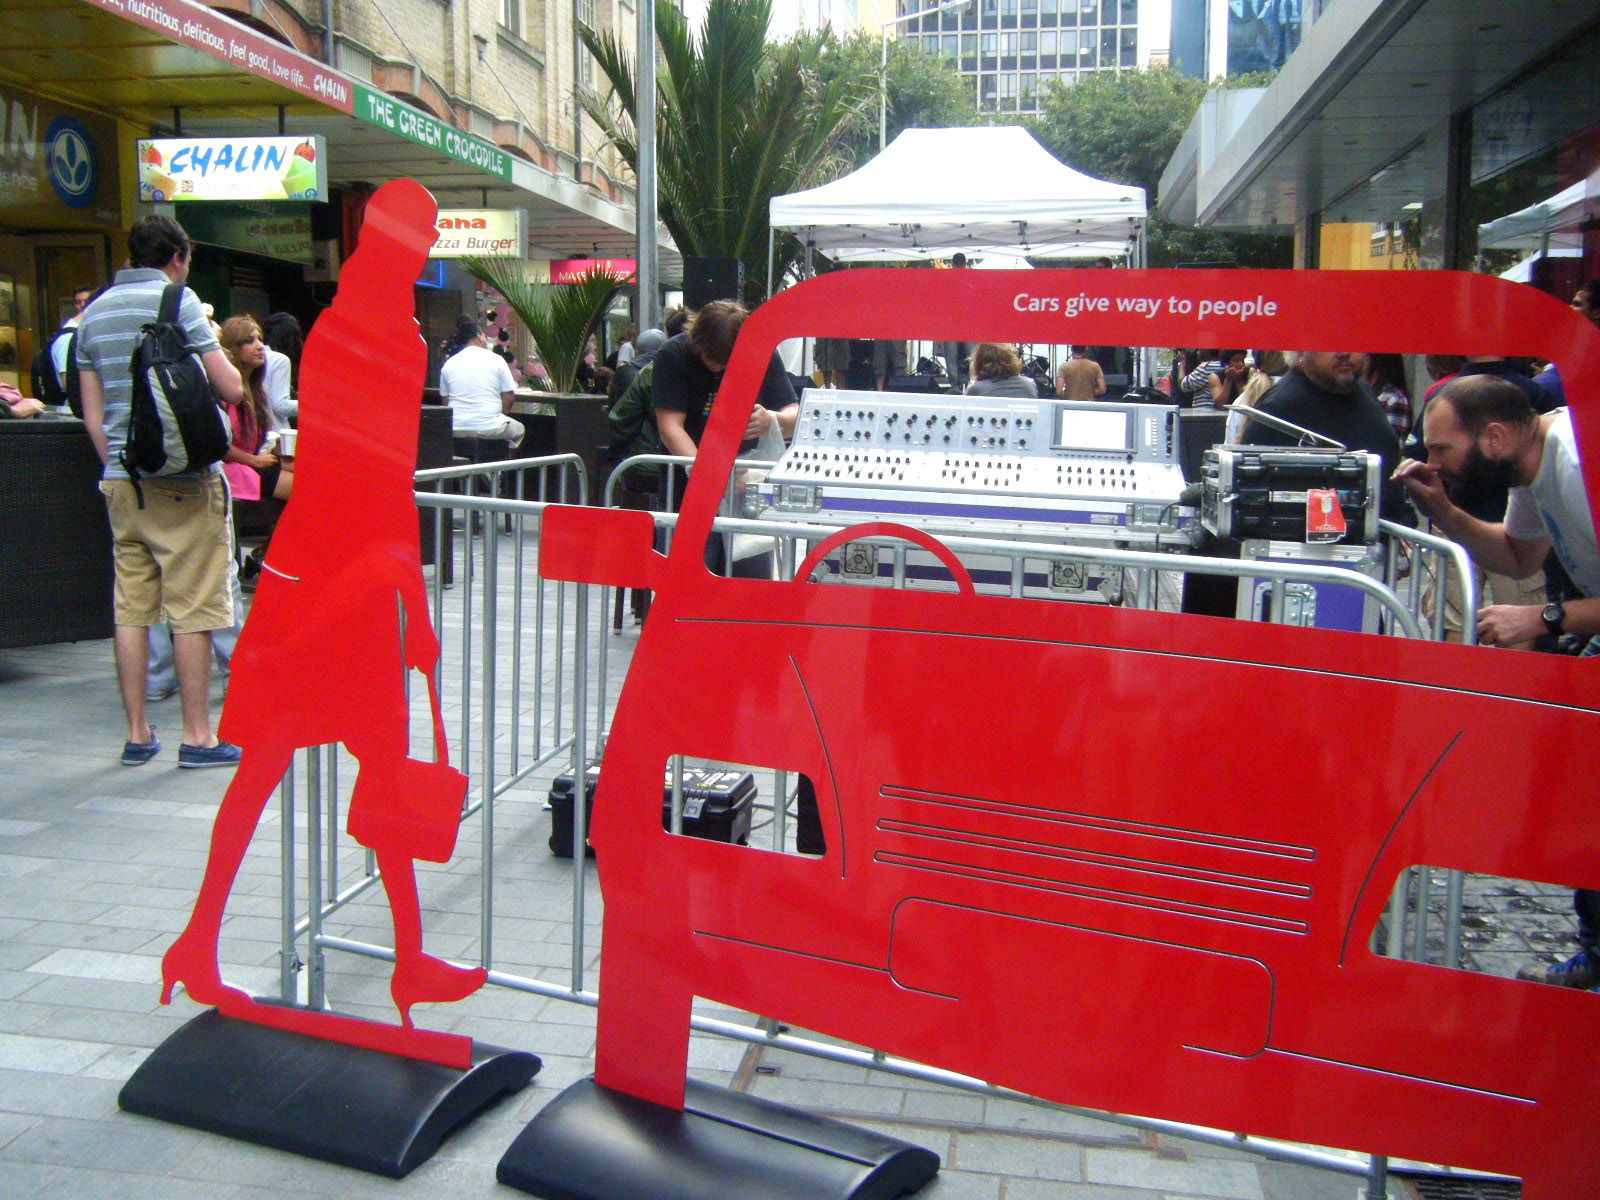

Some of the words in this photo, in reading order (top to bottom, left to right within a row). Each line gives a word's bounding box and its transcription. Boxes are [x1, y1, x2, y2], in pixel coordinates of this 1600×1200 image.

[127, 0, 182, 36] nutritious,
[183, 20, 228, 56] delicious,
[228, 39, 247, 60] feel
[248, 51, 271, 75] good,
[272, 59, 290, 80] love
[313, 74, 347, 104] CHALIN
[367, 94, 395, 129] THE
[399, 110, 441, 148] GREEN
[445, 131, 504, 176] CROCODILE
[170, 144, 288, 177] CHALIN
[437, 217, 487, 230] ana
[433, 238, 460, 249] zza
[466, 237, 516, 252] Burger
[1013, 293, 1060, 312] Cars
[1064, 292, 1110, 318] give
[1115, 296, 1162, 318] way
[1167, 295, 1193, 314] to
[1198, 295, 1278, 322] people
